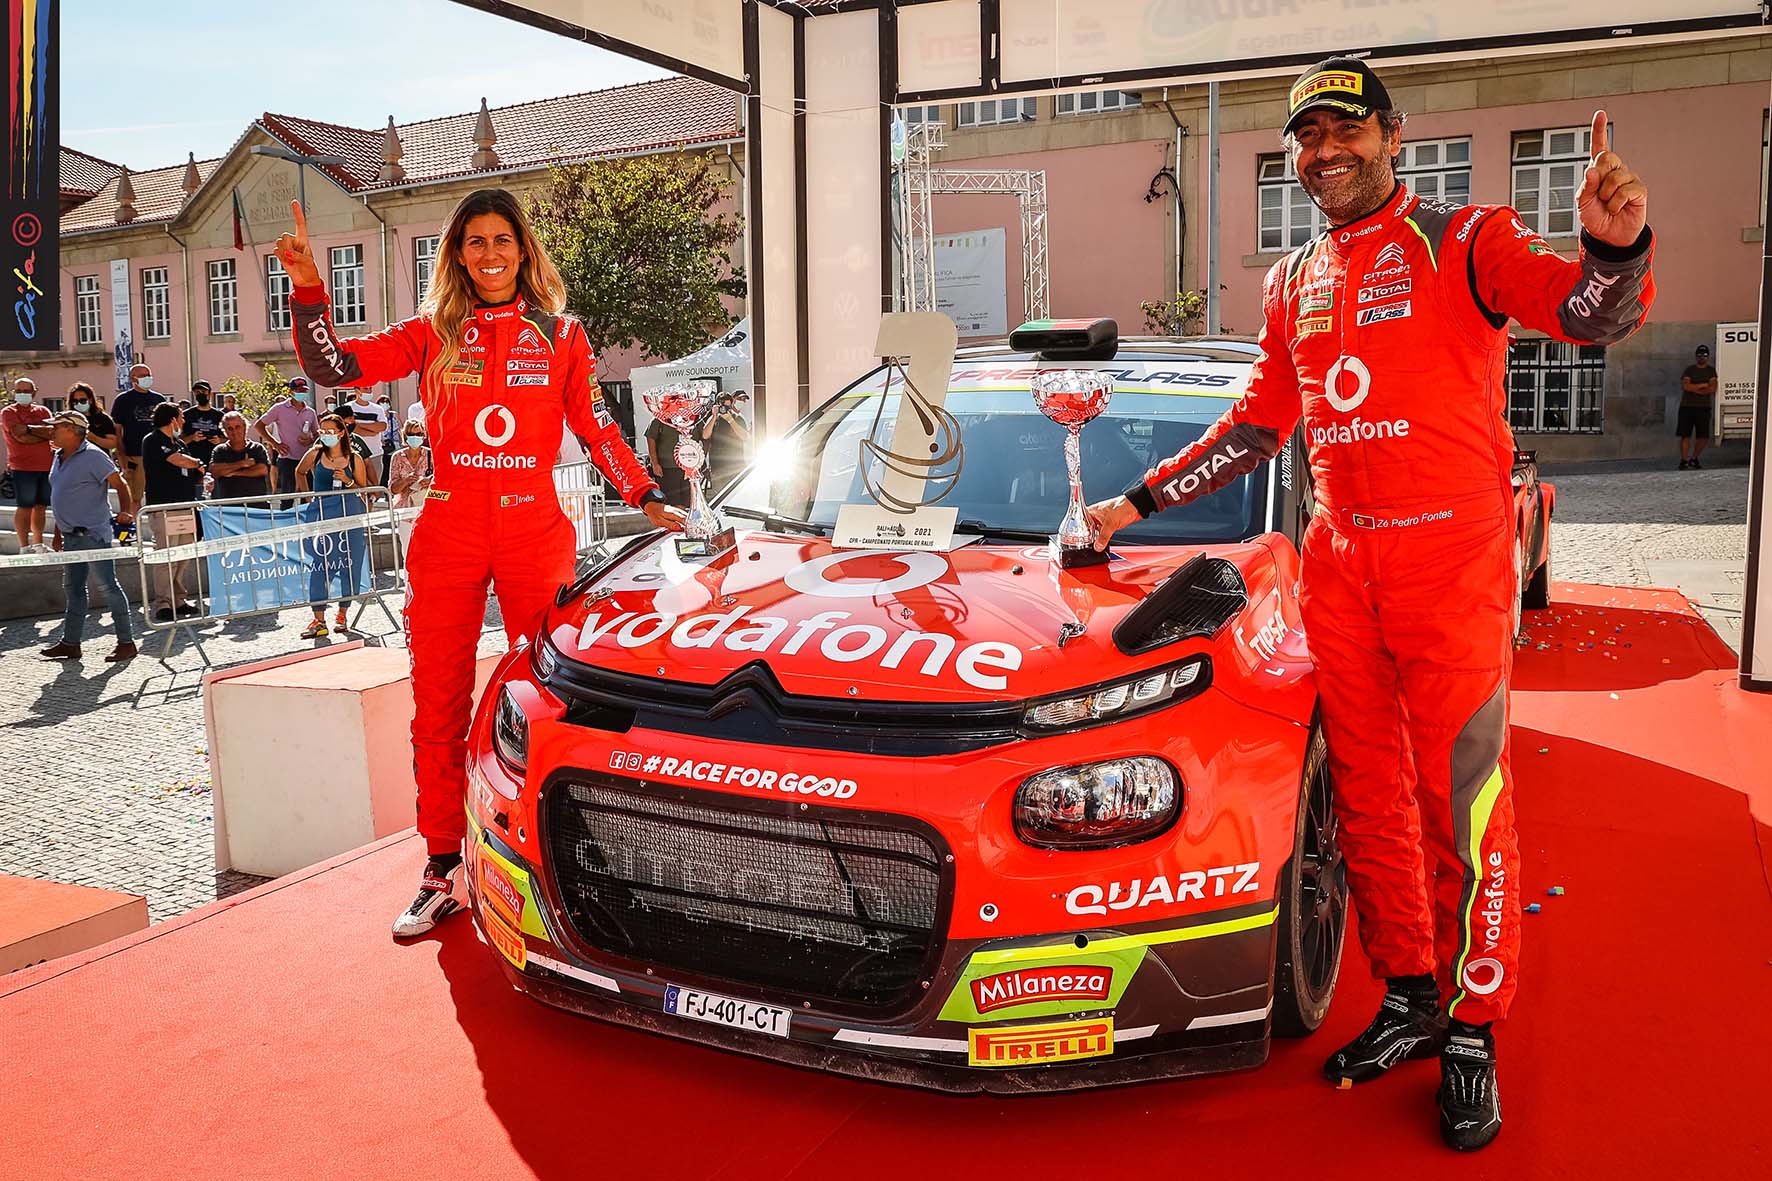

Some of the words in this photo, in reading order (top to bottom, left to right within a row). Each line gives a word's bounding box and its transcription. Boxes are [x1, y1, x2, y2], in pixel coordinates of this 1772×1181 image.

[1293, 74, 1357, 105] PIRELLI
[1351, 223, 1383, 237] vodafone
[1456, 208, 1486, 242] Sabelt
[1373, 284, 1410, 297] TOTAL
[1568, 271, 1620, 318] TOTAL
[1372, 308, 1405, 322] GLASS
[307, 314, 344, 376] TOTAL
[519, 361, 548, 369] TOTAL
[665, 366, 740, 377] WWW.SOUNDSPOT.PT
[1311, 417, 1409, 445] vodafone
[450, 452, 537, 469] vodafone
[1163, 443, 1248, 501] TOTAL
[914, 528, 932, 536] 2021
[1391, 515, 1419, 528] Pedro
[1421, 509, 1453, 524] Fontes
[577, 605, 1022, 691] vodafone
[1249, 609, 1288, 661] TIPSA
[483, 860, 520, 914] Milaneza
[1065, 862, 1260, 916] QUARTZ
[1482, 851, 1505, 953] vodafone
[485, 908, 523, 963] PIRELLI
[979, 972, 1104, 1005] Milaneza
[669, 1001, 674, 1009] F
[685, 992, 783, 1032] FJ-401-CT
[976, 1024, 1108, 1061] PIRELLI
